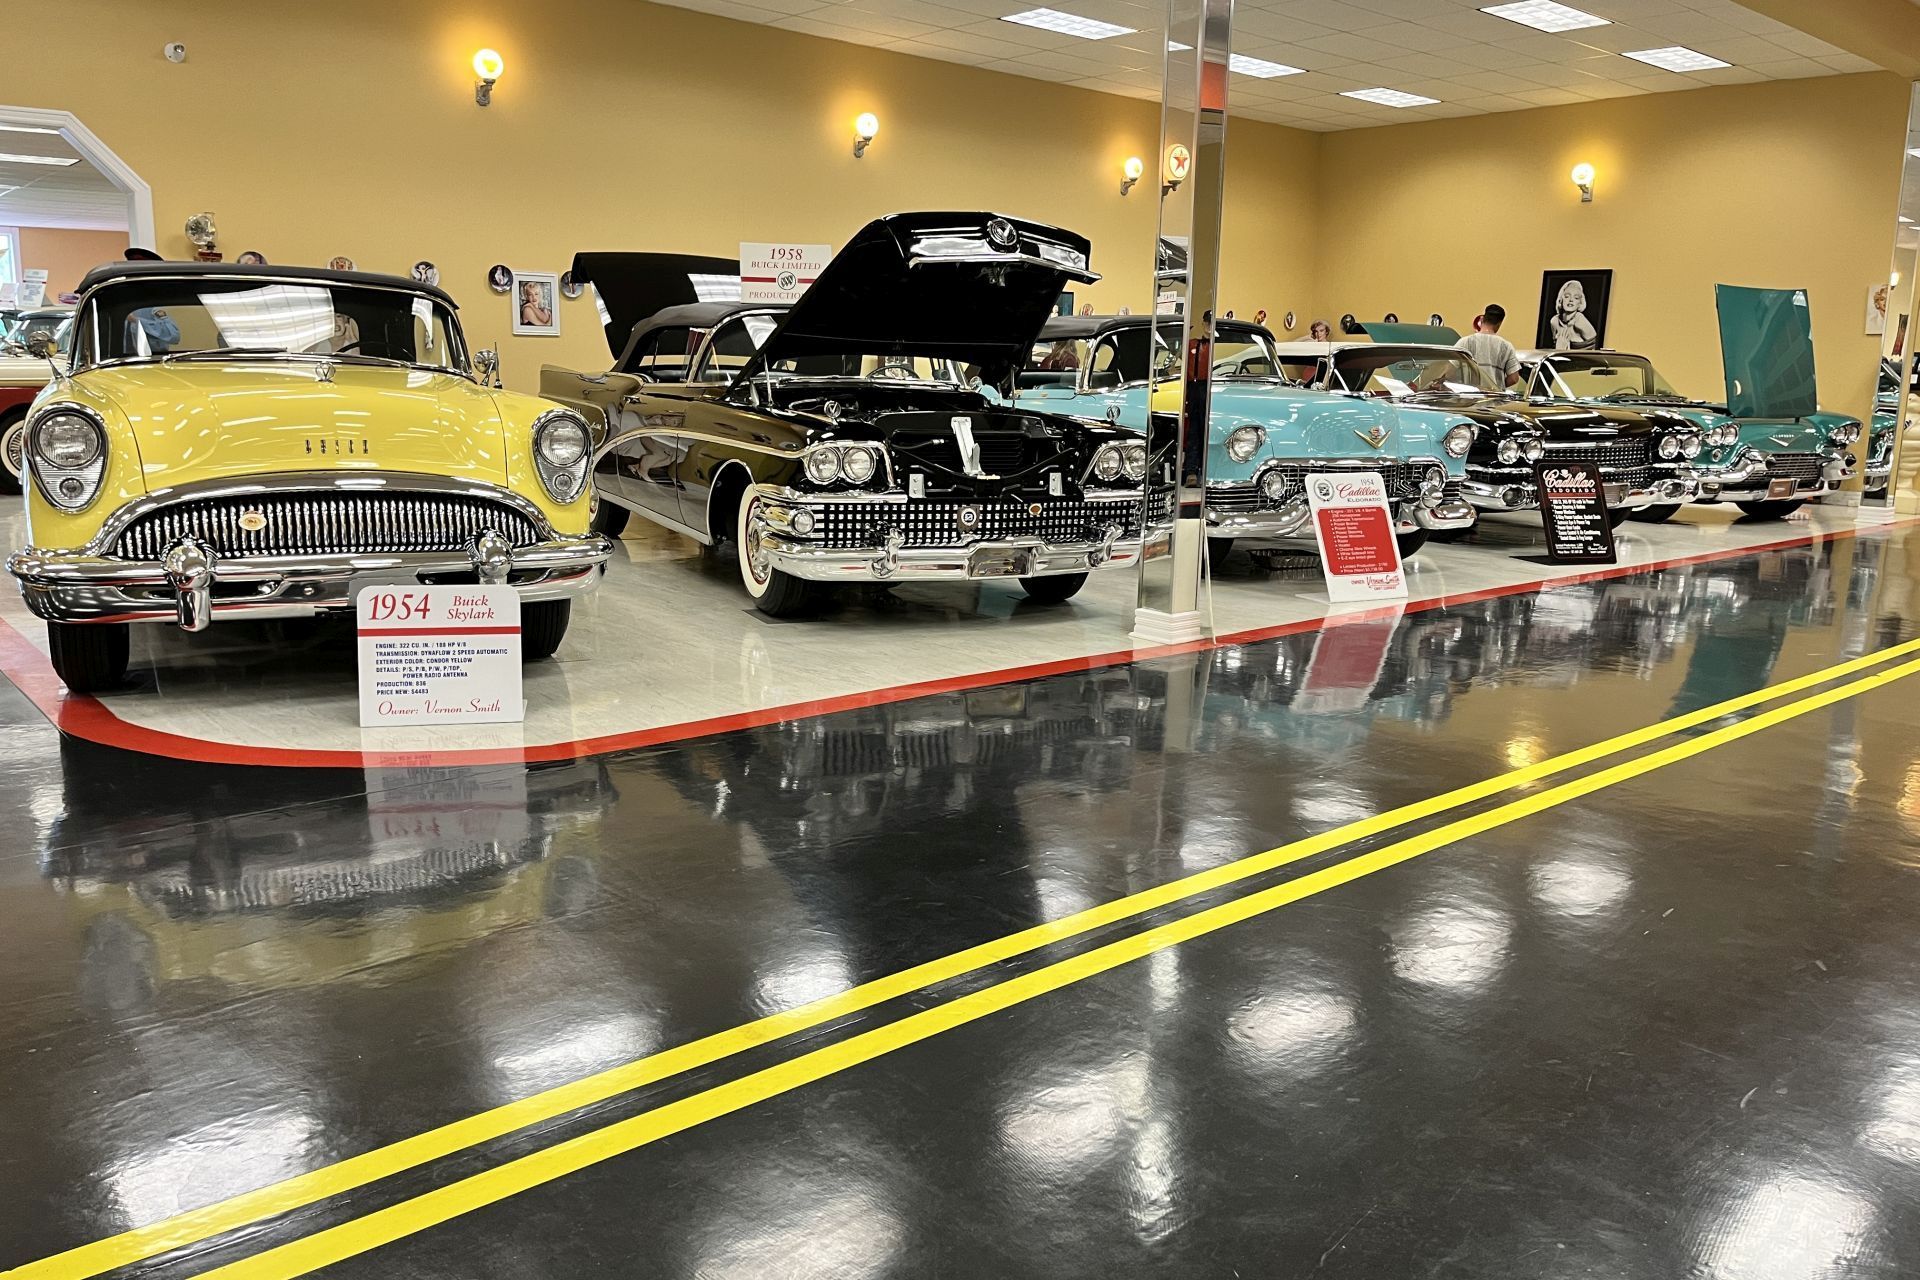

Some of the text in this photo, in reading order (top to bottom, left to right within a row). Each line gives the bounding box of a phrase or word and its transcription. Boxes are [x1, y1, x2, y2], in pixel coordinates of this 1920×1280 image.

[770, 248, 803, 260] 1958
[751, 261, 821, 270] BUICK LIMITED
[749, 291, 803, 300] PRODUCTIO
[1542, 469, 1596, 488] Cadillac
[1336, 483, 1381, 499] Cadillac
[368, 593, 488, 621] 1954 Buick
[447, 608, 495, 622] Skylark
[378, 698, 500, 716] Owner: Vernon Smith
